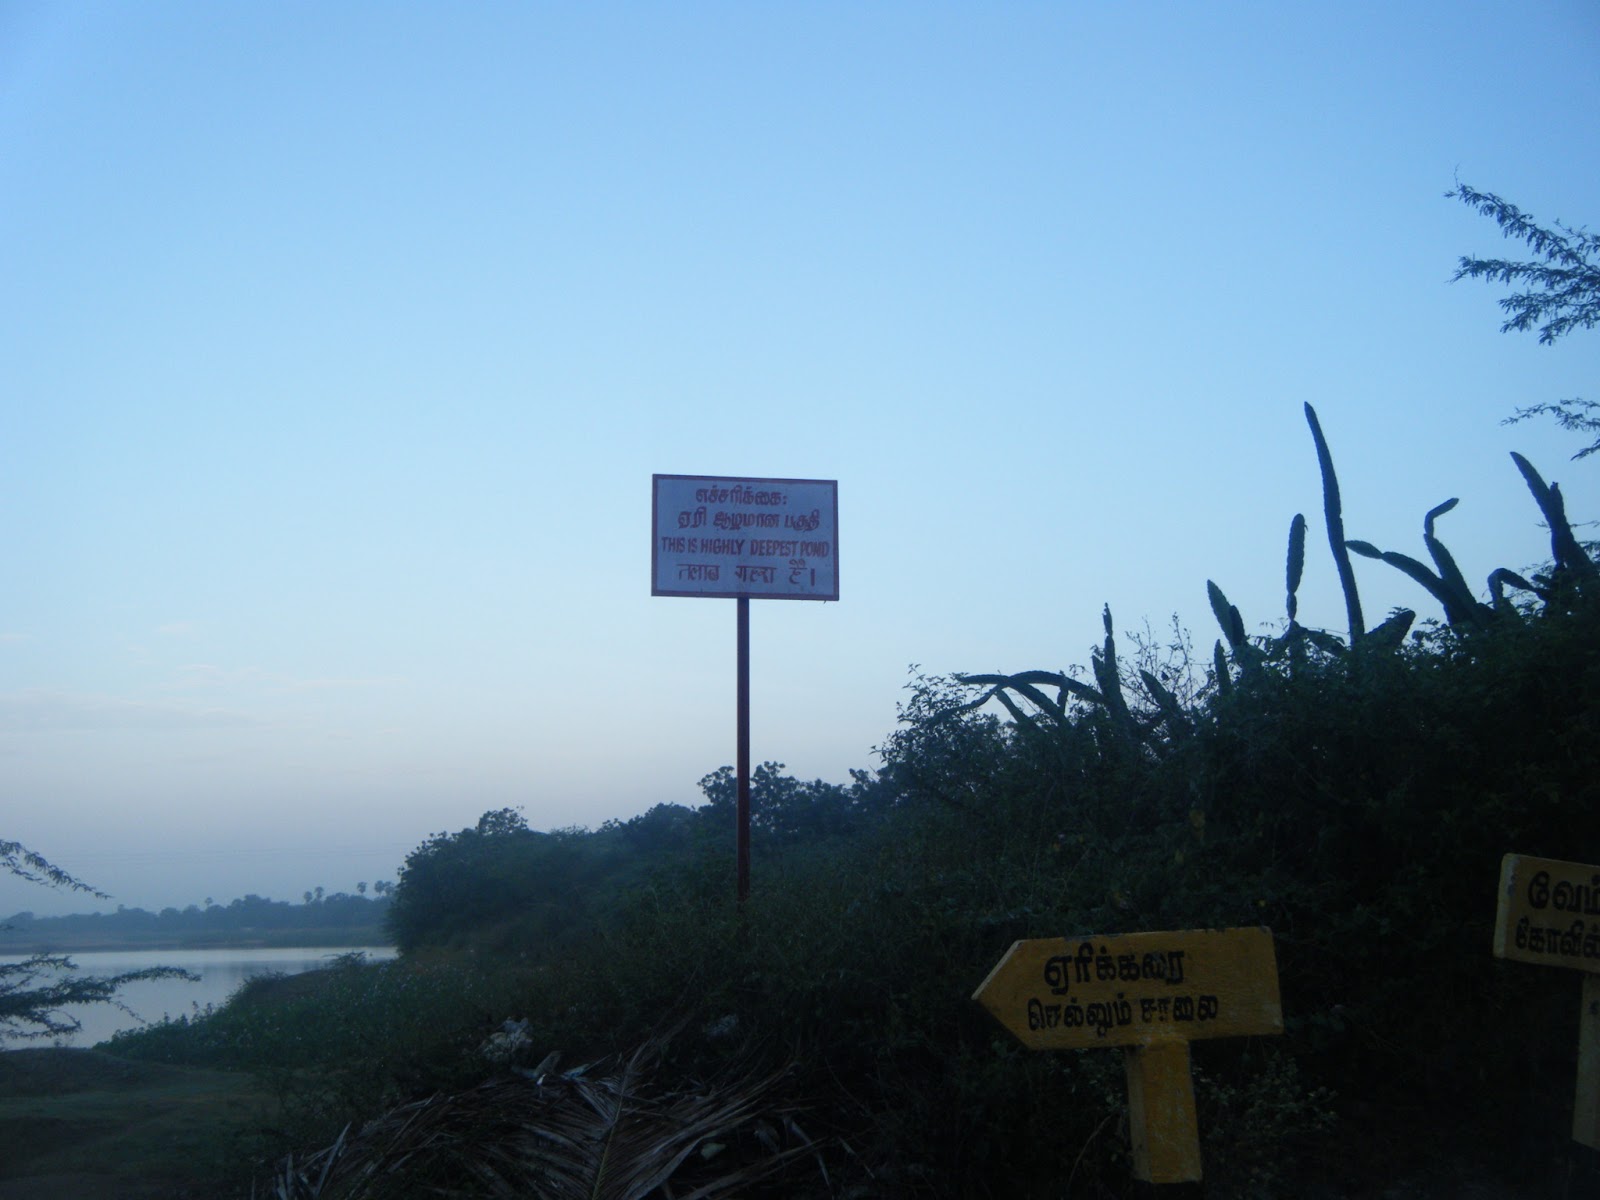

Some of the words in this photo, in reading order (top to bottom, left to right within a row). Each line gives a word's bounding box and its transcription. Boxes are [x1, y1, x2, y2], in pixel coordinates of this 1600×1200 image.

[677, 506, 707, 529] ஏரி
[713, 510, 780, 531] ஆழமான
[785, 508, 820, 532] பகுதி
[661, 537, 686, 553] THIS
[687, 537, 698, 553] IS
[700, 538, 745, 555] HIGHLY
[750, 539, 799, 557] DEEPEST
[799, 540, 830, 558] POND
[1043, 941, 1185, 996] ஏரிக்கரை
[1027, 992, 1132, 1038] செல்லும்
[1140, 994, 1219, 1023] சாலை
